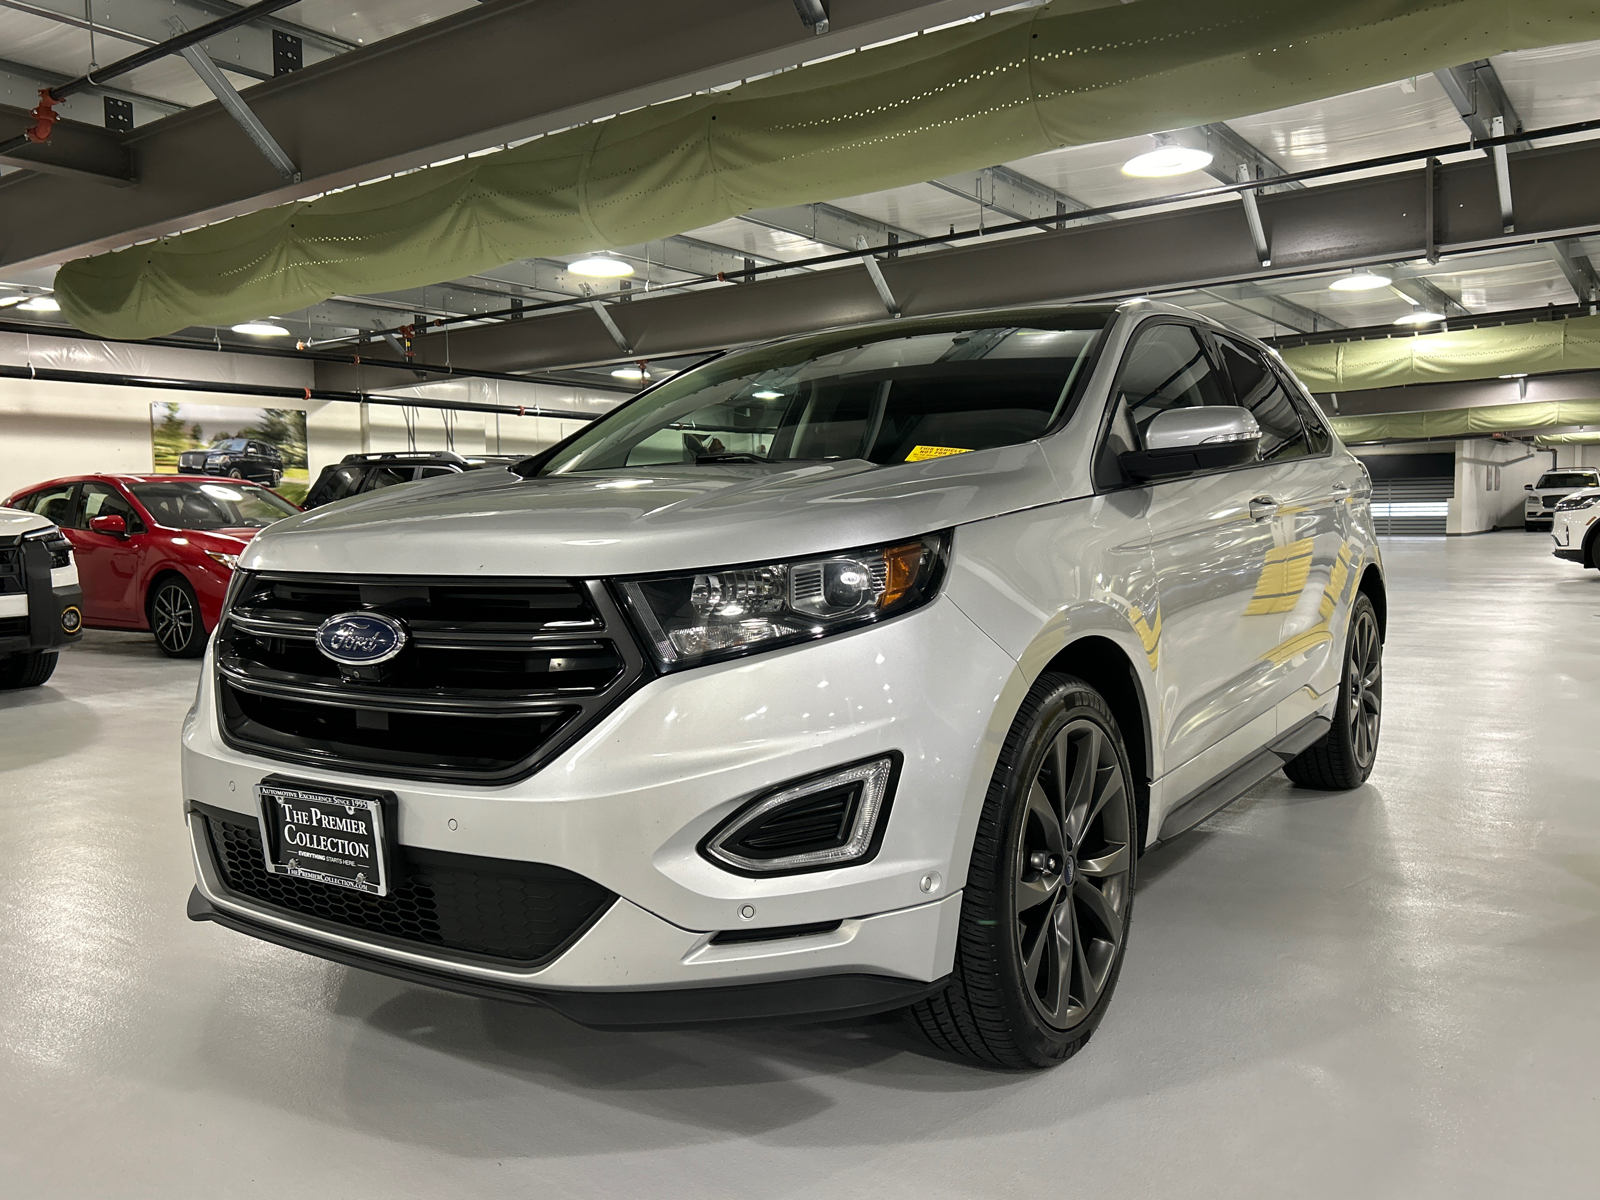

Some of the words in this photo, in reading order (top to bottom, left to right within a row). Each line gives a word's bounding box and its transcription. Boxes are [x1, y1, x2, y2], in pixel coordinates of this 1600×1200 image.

[330, 622, 380, 652] Ford
[281, 804, 310, 826] THE
[310, 807, 368, 836] PREMIER
[284, 824, 370, 858] COLLECTION
[298, 850, 326, 861] EVERYTHING
[326, 855, 343, 865] STARTS
